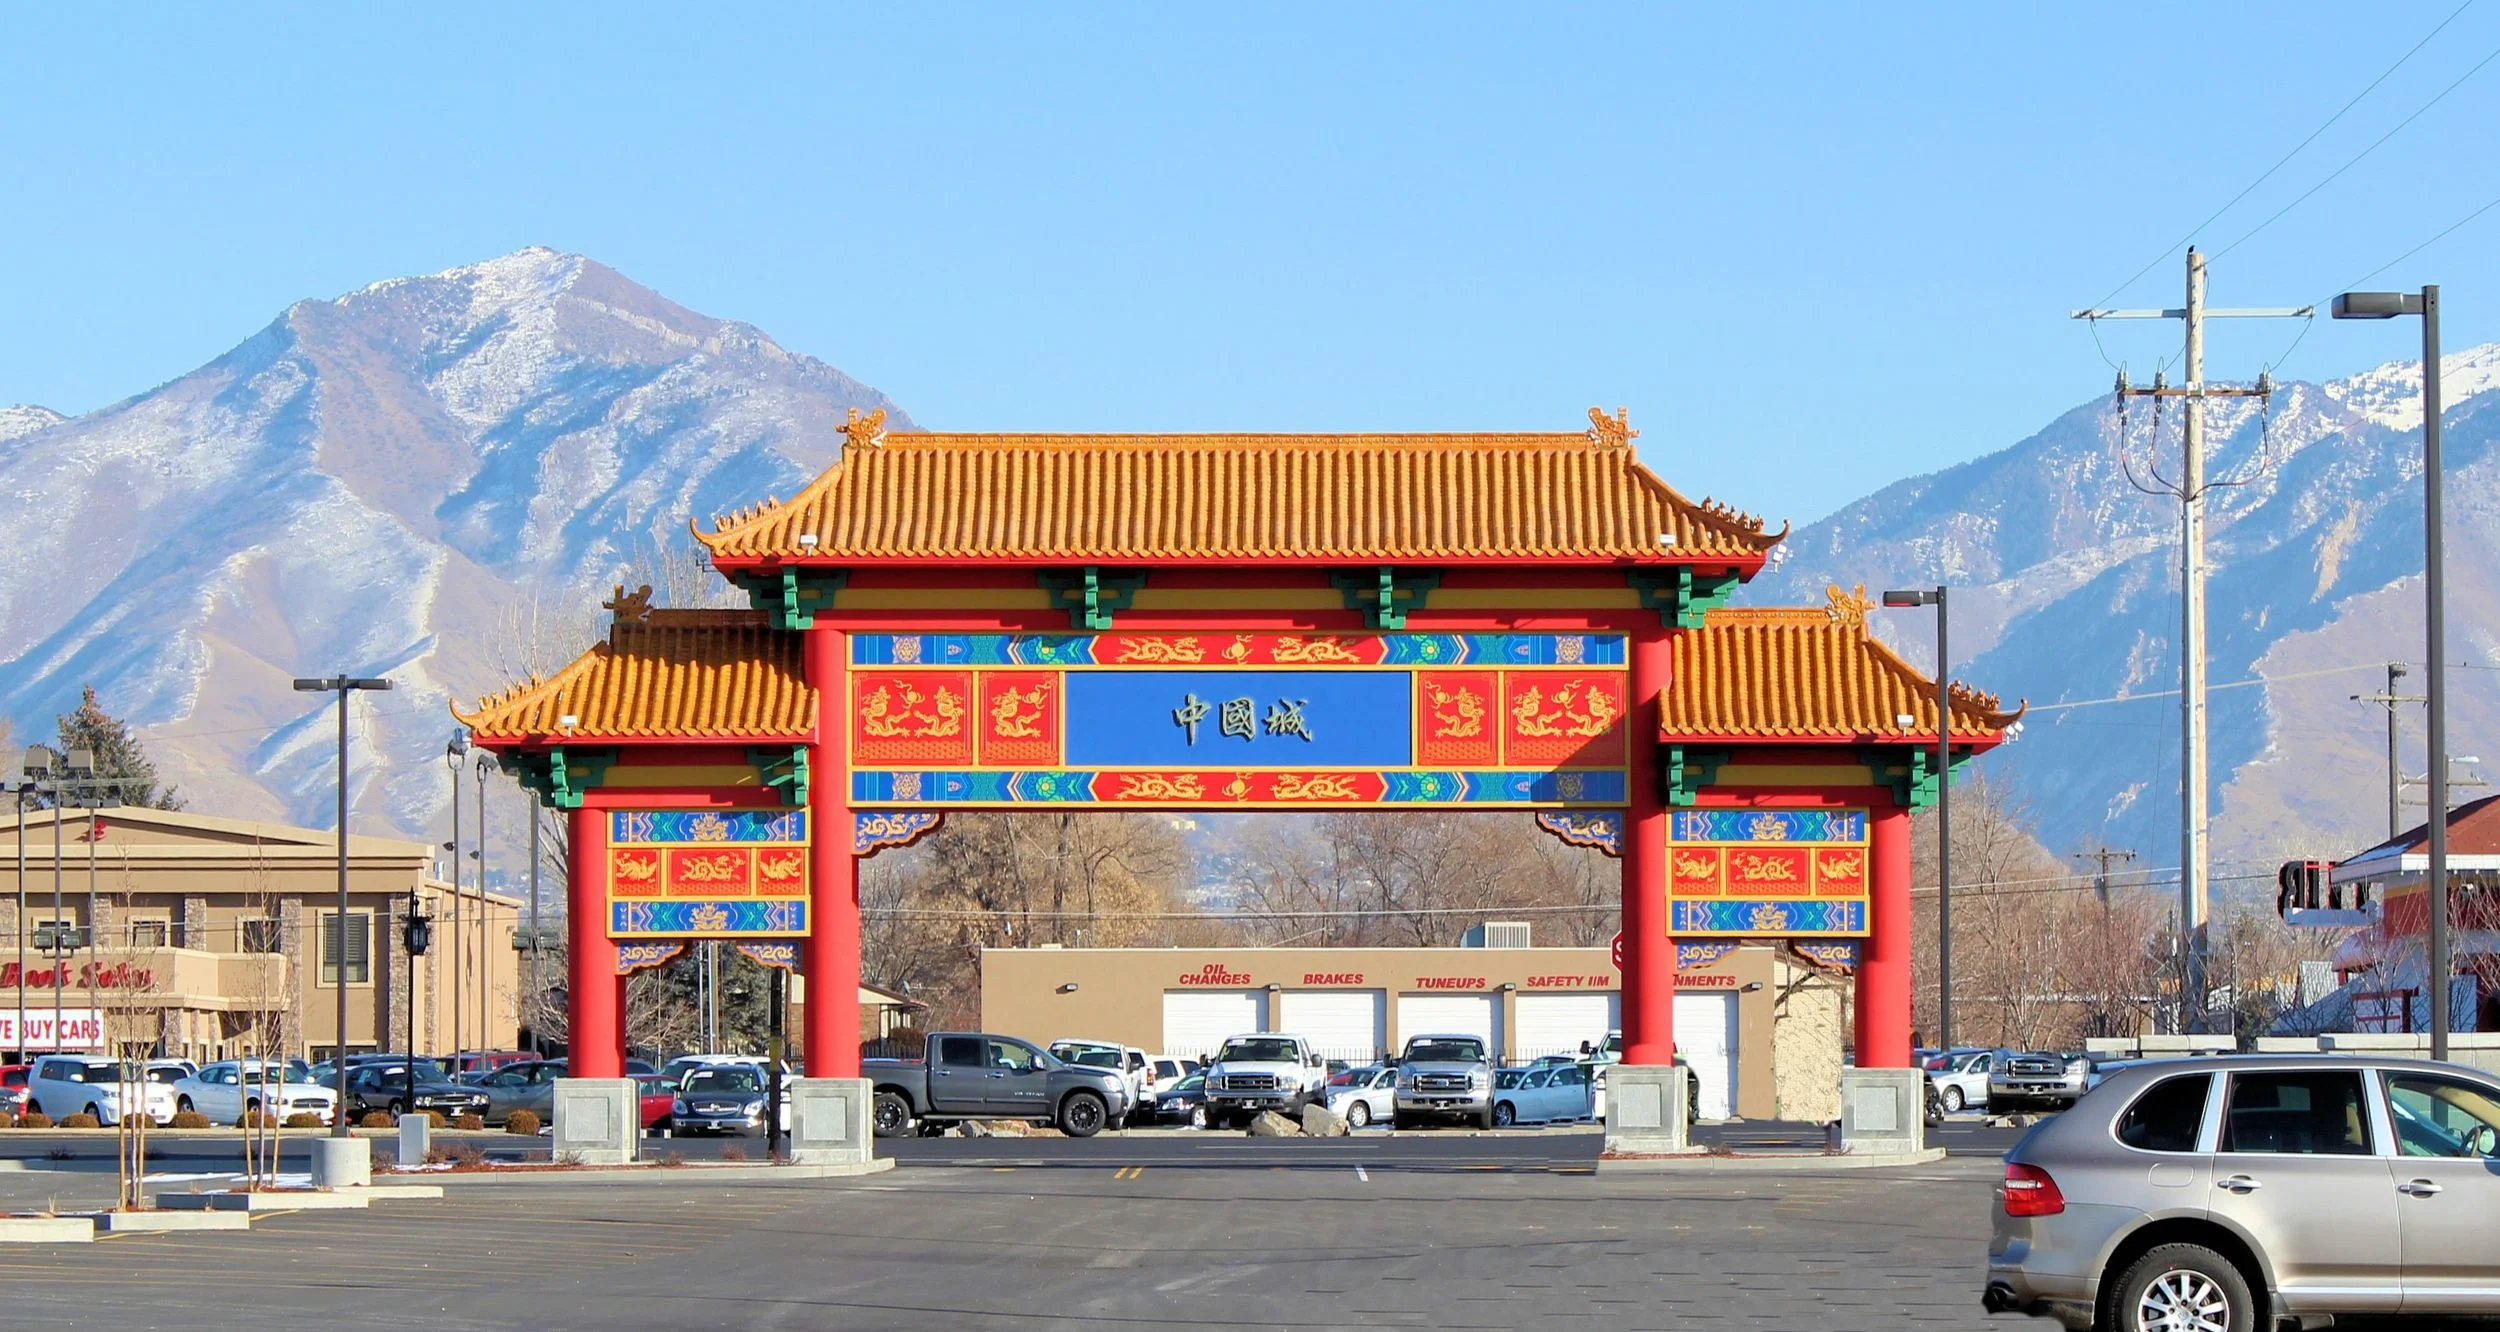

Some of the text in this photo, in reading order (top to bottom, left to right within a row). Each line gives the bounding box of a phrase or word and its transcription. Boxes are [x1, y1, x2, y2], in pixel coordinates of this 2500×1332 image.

[1173, 693, 1313, 746] 中國城
[1203, 964, 1226, 975] OIL
[1179, 974, 1251, 985] CHANGES
[1303, 974, 1364, 985] BRAKES
[1416, 977, 1486, 989] TUNEUPS
[1527, 976, 1584, 987] SAFETY
[59, 1020, 100, 1039] CARS
